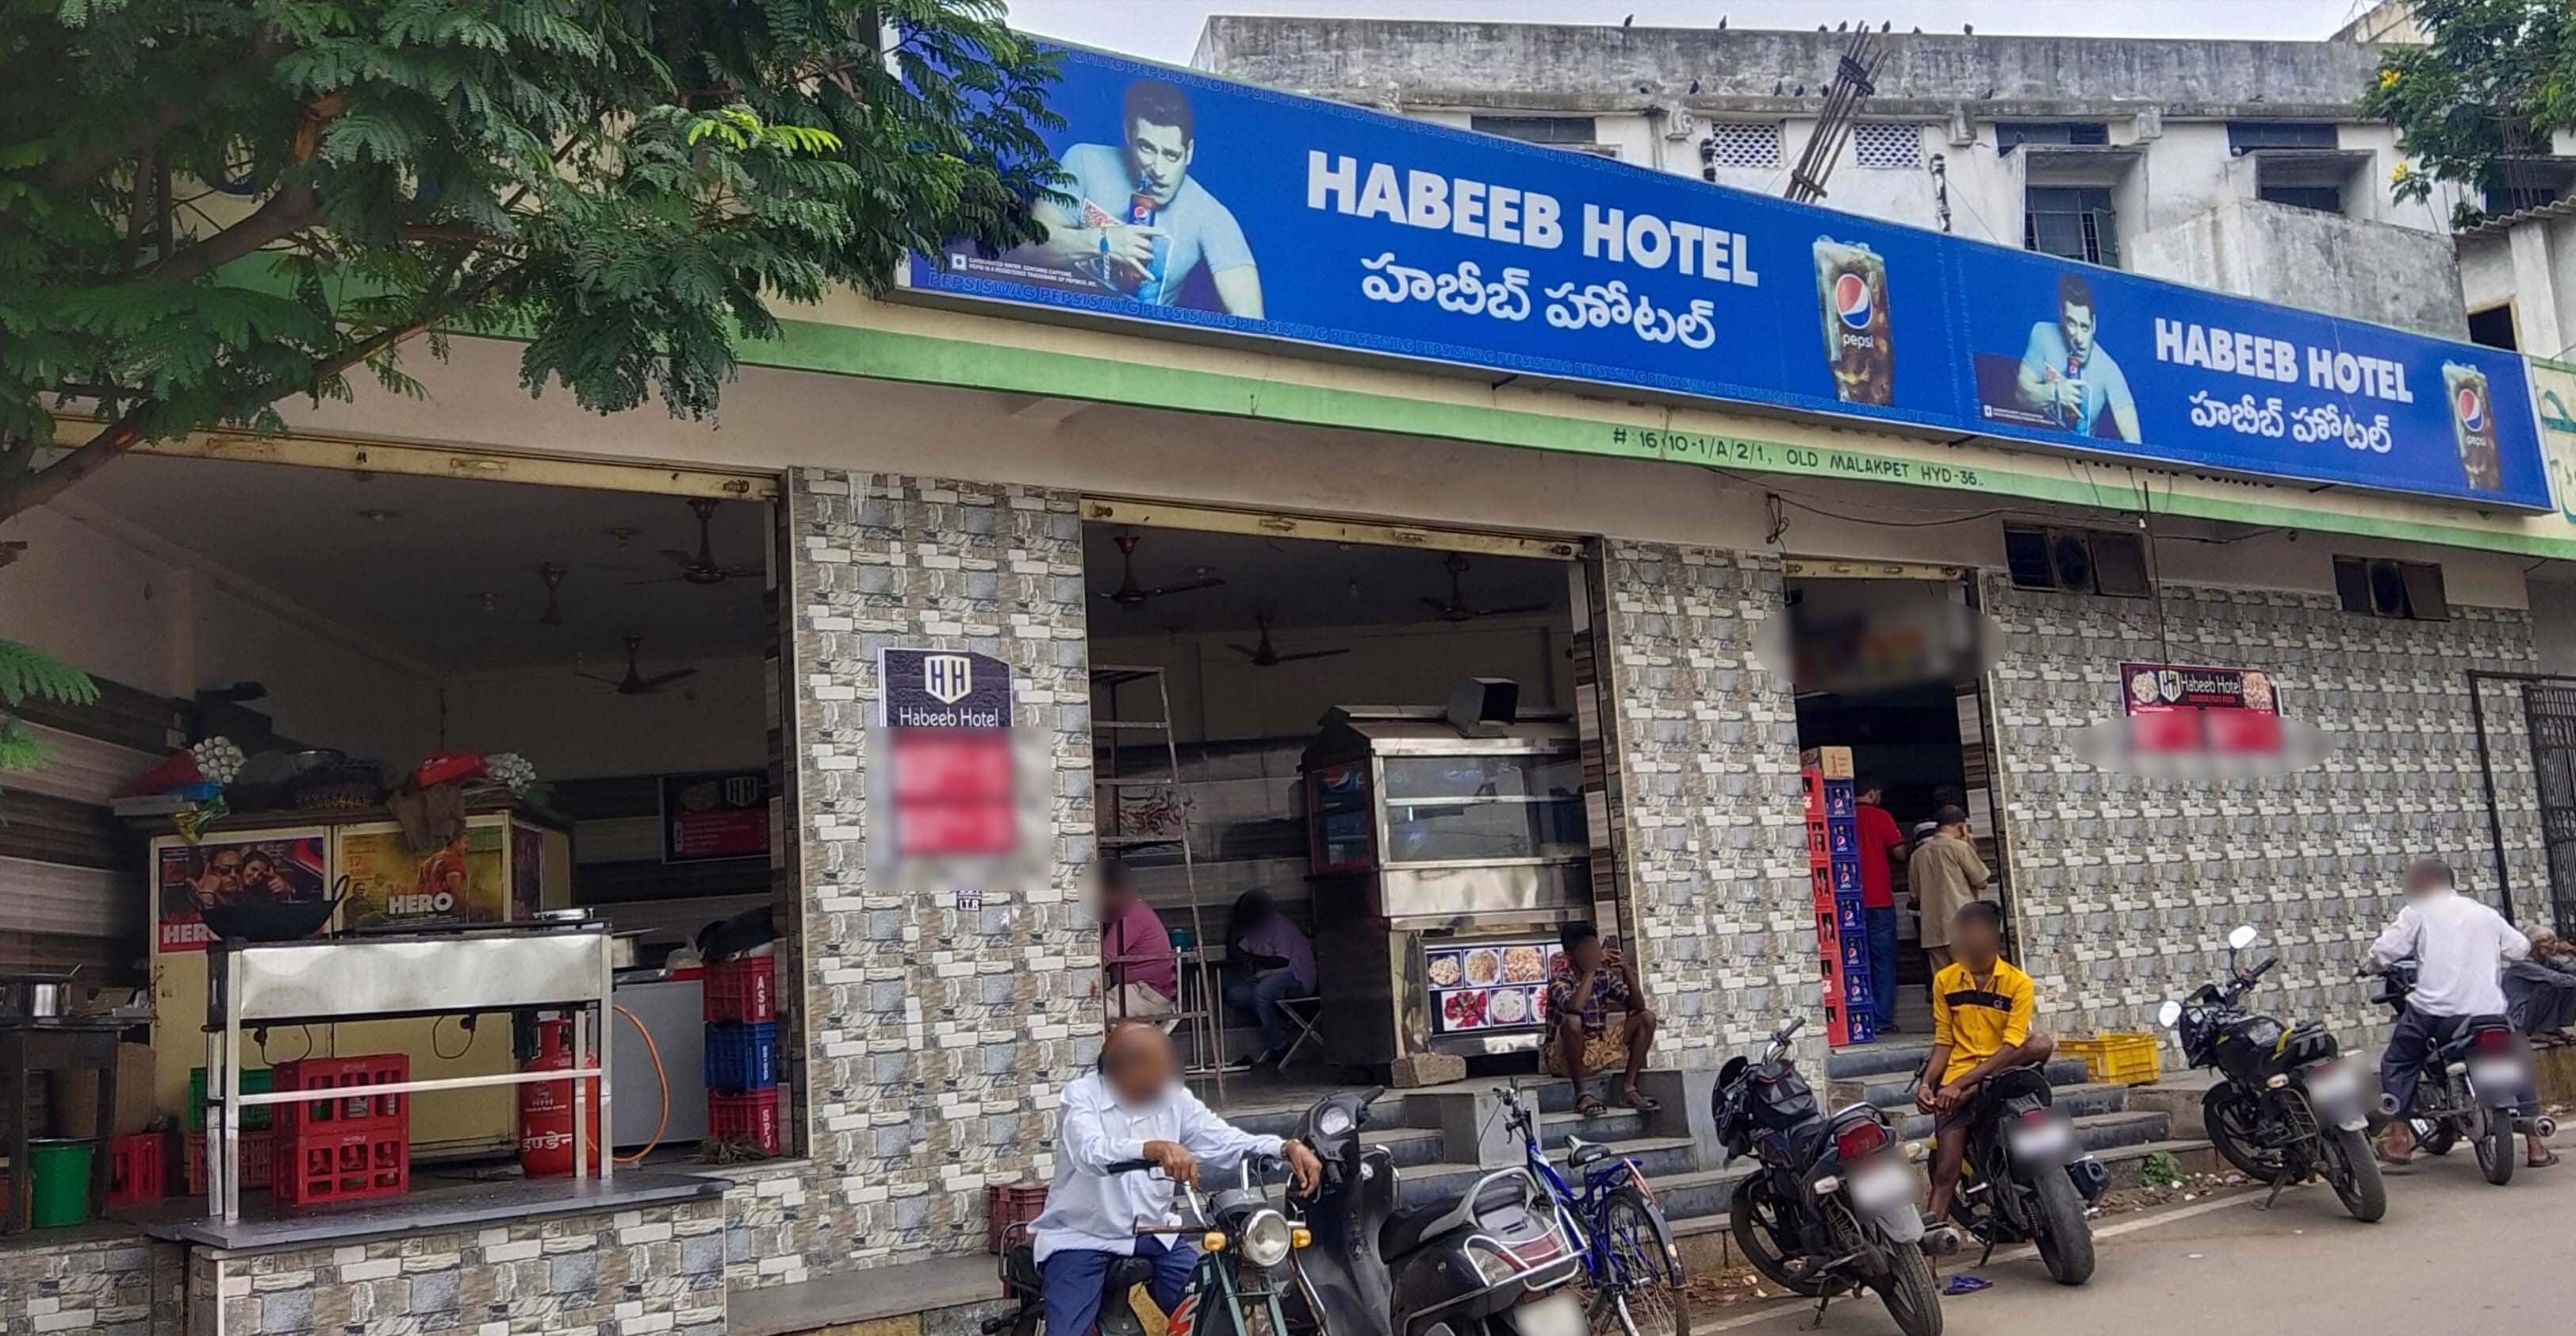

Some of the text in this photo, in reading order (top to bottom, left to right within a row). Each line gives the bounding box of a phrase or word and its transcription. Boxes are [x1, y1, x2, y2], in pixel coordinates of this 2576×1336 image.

[1307, 150, 1758, 287] HABEEB HOTEL
[928, 272, 1037, 299] PEPSISWAG
[1039, 287, 1141, 313] PEPSISWAG
[1142, 303, 1237, 328] PEPSISWAG
[1361, 252, 1715, 349] హబీబ్ హోటల్
[1843, 332, 1874, 350] pepsi
[2155, 317, 2413, 404] HABEEB HOTEL
[2189, 390, 2393, 454] హబీబ్ హోటల్
[1786, 449, 1819, 467] OLD
[1830, 455, 1910, 478] MALAKPET
[2180, 673, 2242, 694] Habeeb Hotel
[900, 705, 999, 727] Habeeb Hotel
[388, 891, 454, 916] HERO
[163, 923, 223, 943] HER
